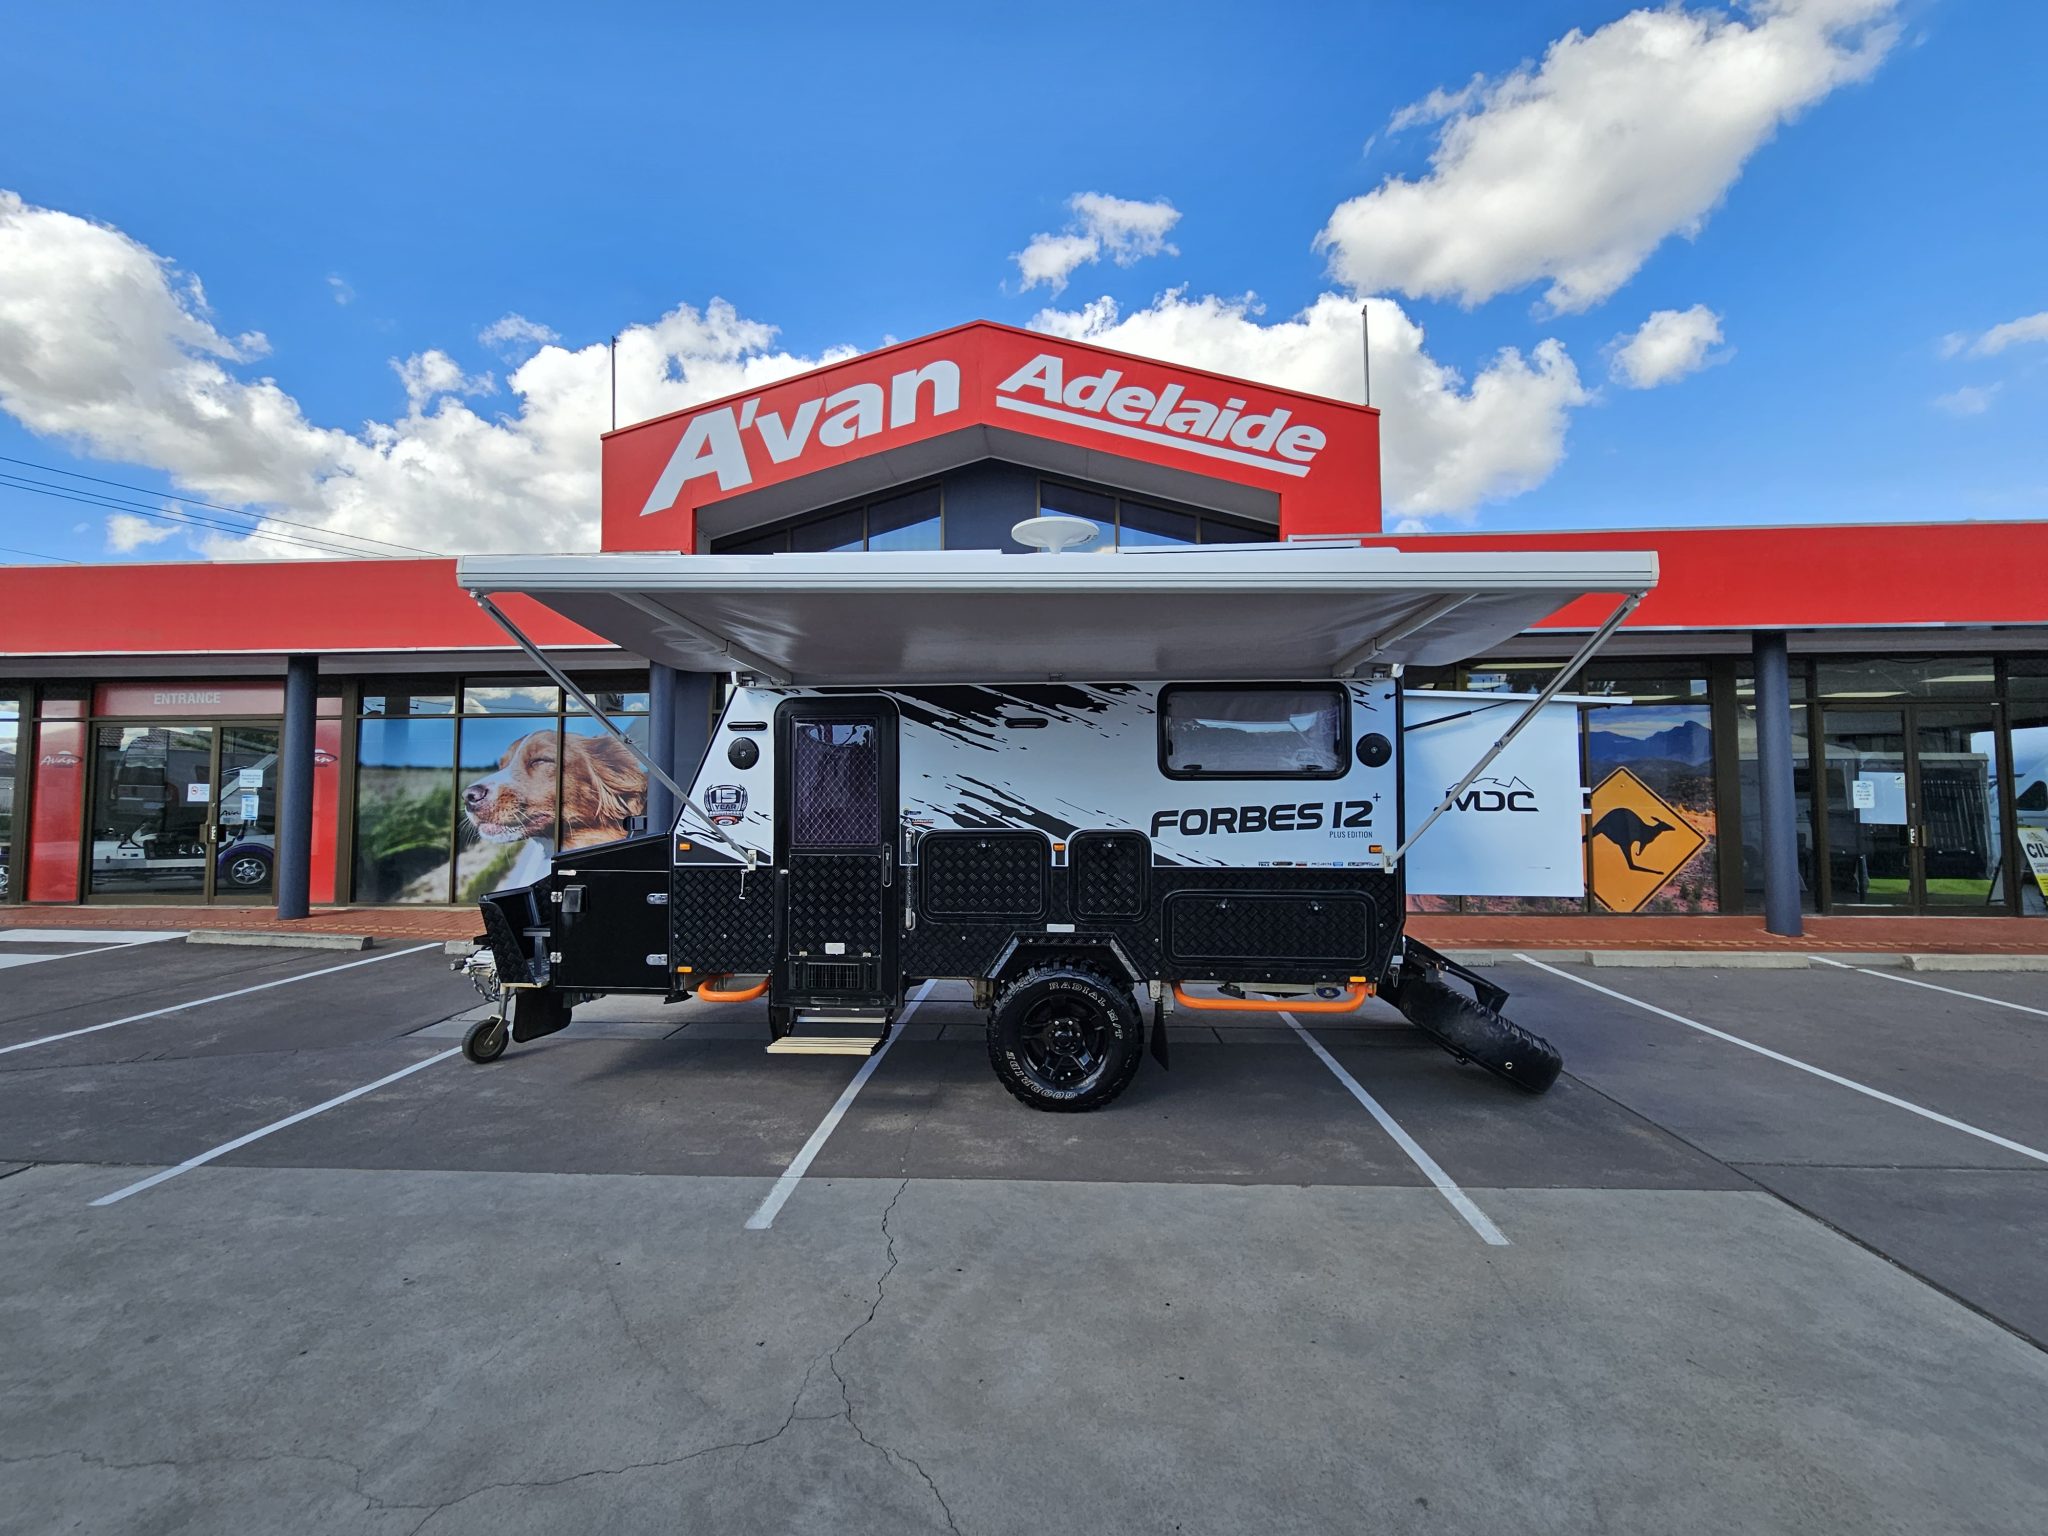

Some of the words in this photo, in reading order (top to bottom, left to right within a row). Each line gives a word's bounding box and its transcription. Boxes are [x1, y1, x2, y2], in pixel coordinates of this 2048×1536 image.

[996, 353, 1327, 463] Adelaide
[640, 360, 961, 517] A'van
[153, 691, 221, 705] ENTRANCE
[715, 789, 737, 803] 15
[1433, 790, 1540, 812] MDC
[1150, 803, 1324, 838] FORBES
[1329, 831, 1346, 839] PLUS
[1347, 831, 1373, 839] EDITION
[1048, 981, 1107, 1007] RADIAL
[1005, 1050, 1078, 1100] GOODRIDE
